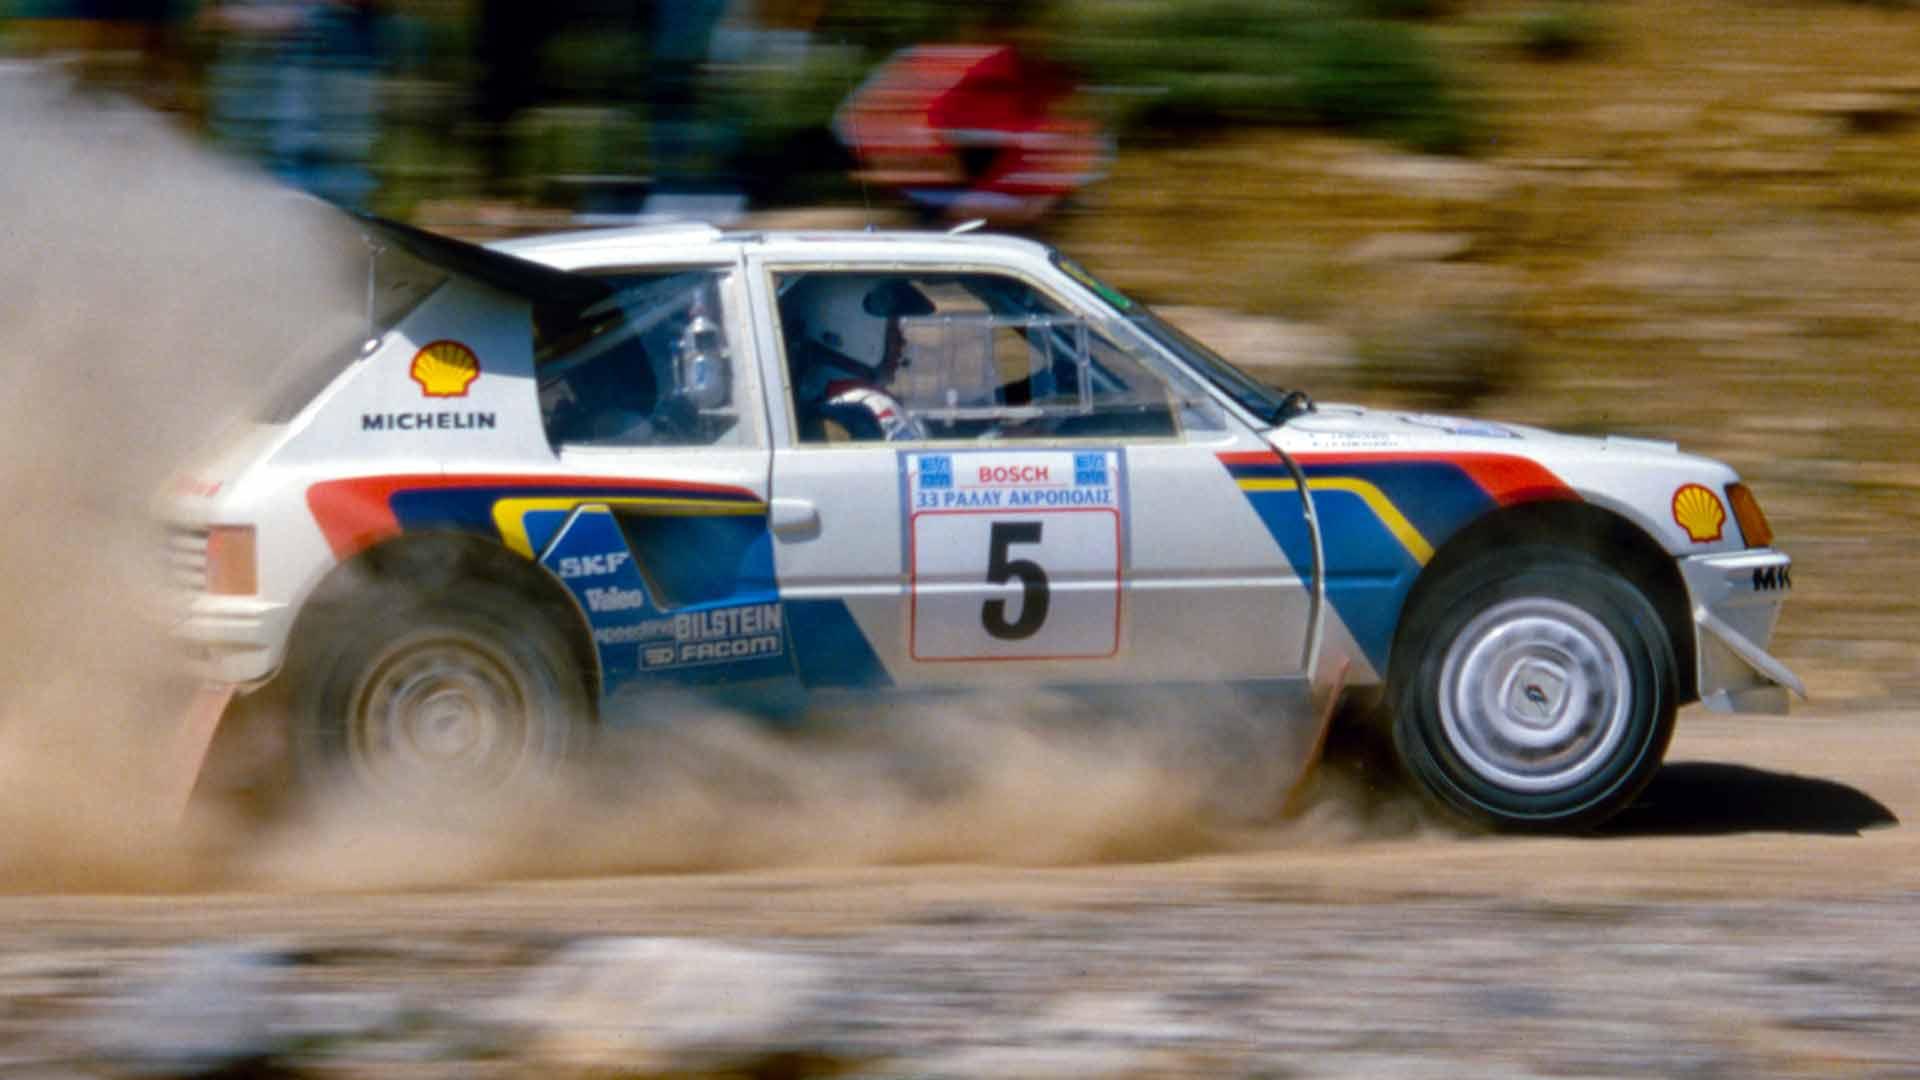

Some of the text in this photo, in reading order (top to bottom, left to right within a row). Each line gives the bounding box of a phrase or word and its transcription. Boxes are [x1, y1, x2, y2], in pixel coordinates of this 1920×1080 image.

[362, 412, 497, 430] MICHELIN
[979, 465, 1049, 483] BOSCH
[917, 492, 939, 508] 33
[559, 551, 630, 578] SKF
[981, 521, 1050, 641] 5
[674, 603, 783, 641] BILSTEIN
